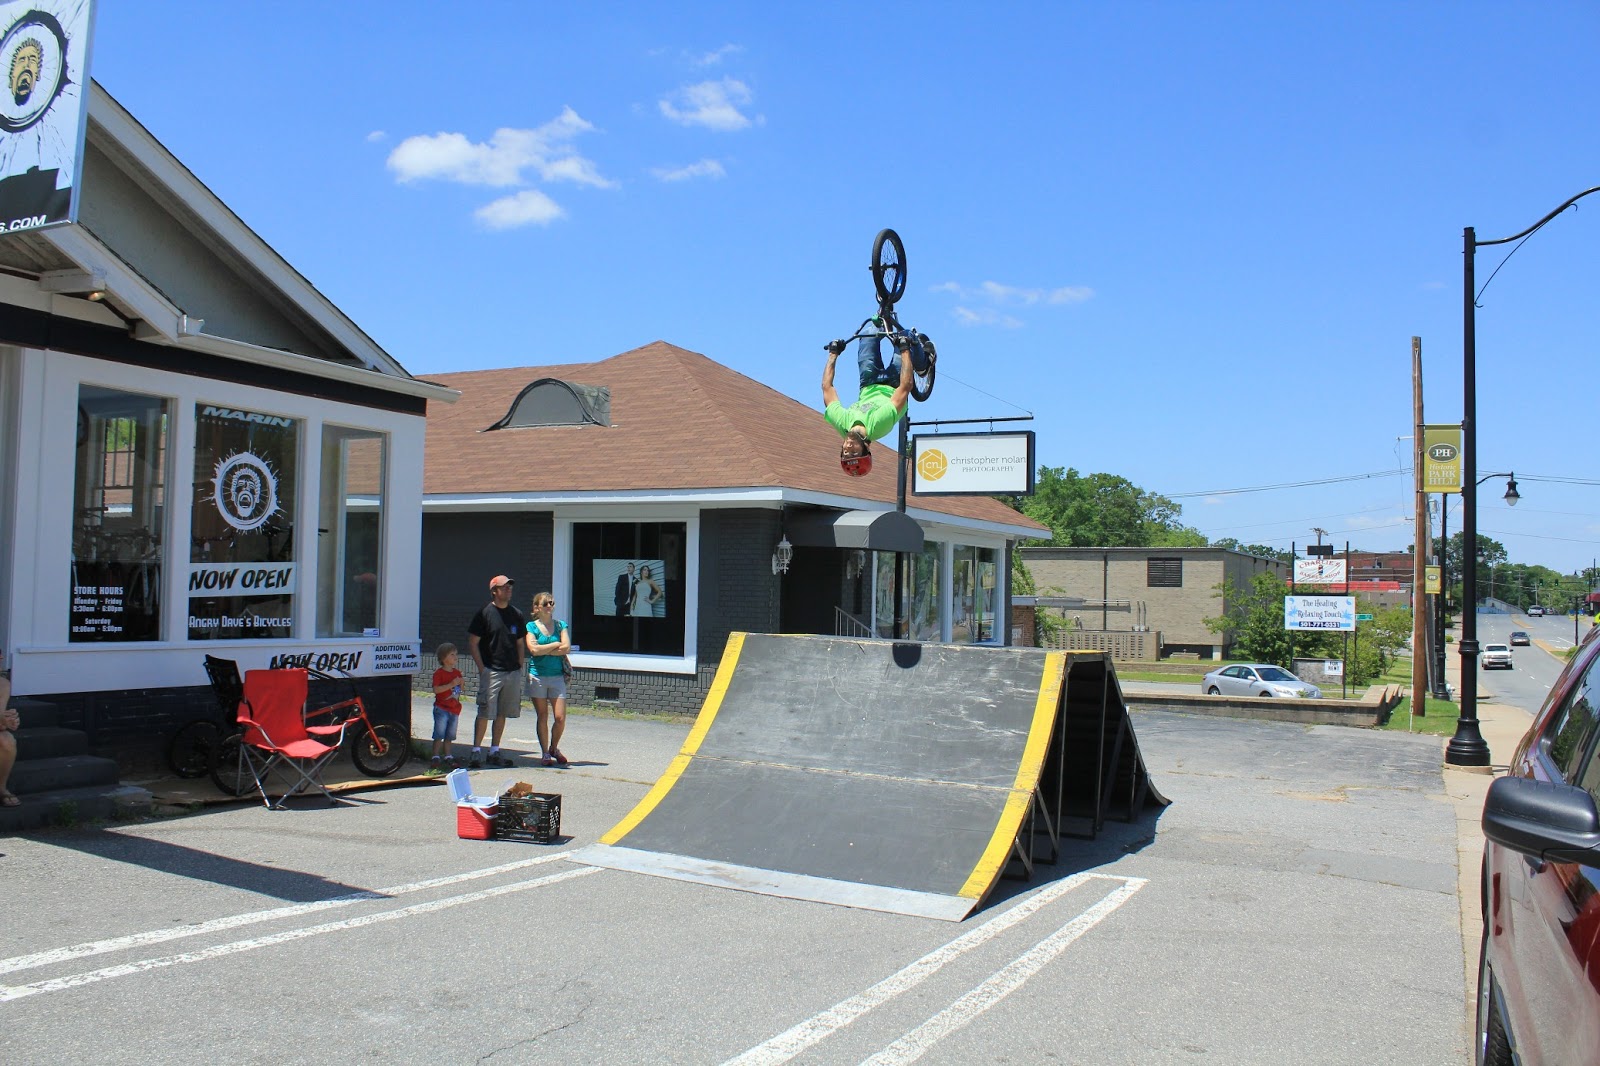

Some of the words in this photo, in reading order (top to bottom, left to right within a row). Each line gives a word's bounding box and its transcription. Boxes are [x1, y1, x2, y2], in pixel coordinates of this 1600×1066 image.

[202, 406, 292, 428] MARIN
[1435, 449, 1451, 457] PH
[950, 455, 1000, 466] christopher
[1001, 456, 1026, 464] nolan
[962, 465, 1015, 473] PHOTOGRAPHY
[189, 568, 240, 591] NOW
[241, 568, 293, 589] OPEN
[73, 587, 97, 595] STORE
[99, 587, 124, 595] HOURS
[74, 597, 98, 605] Monday
[105, 597, 123, 606] Friday
[1302, 599, 1314, 607] The
[1314, 599, 1338, 610] Healing
[1297, 610, 1323, 620] Relaxing
[1324, 610, 1342, 619] Touch
[315, 651, 364, 672] OPEN
[375, 653, 403, 661] PARKING
[375, 662, 401, 670] AROUND
